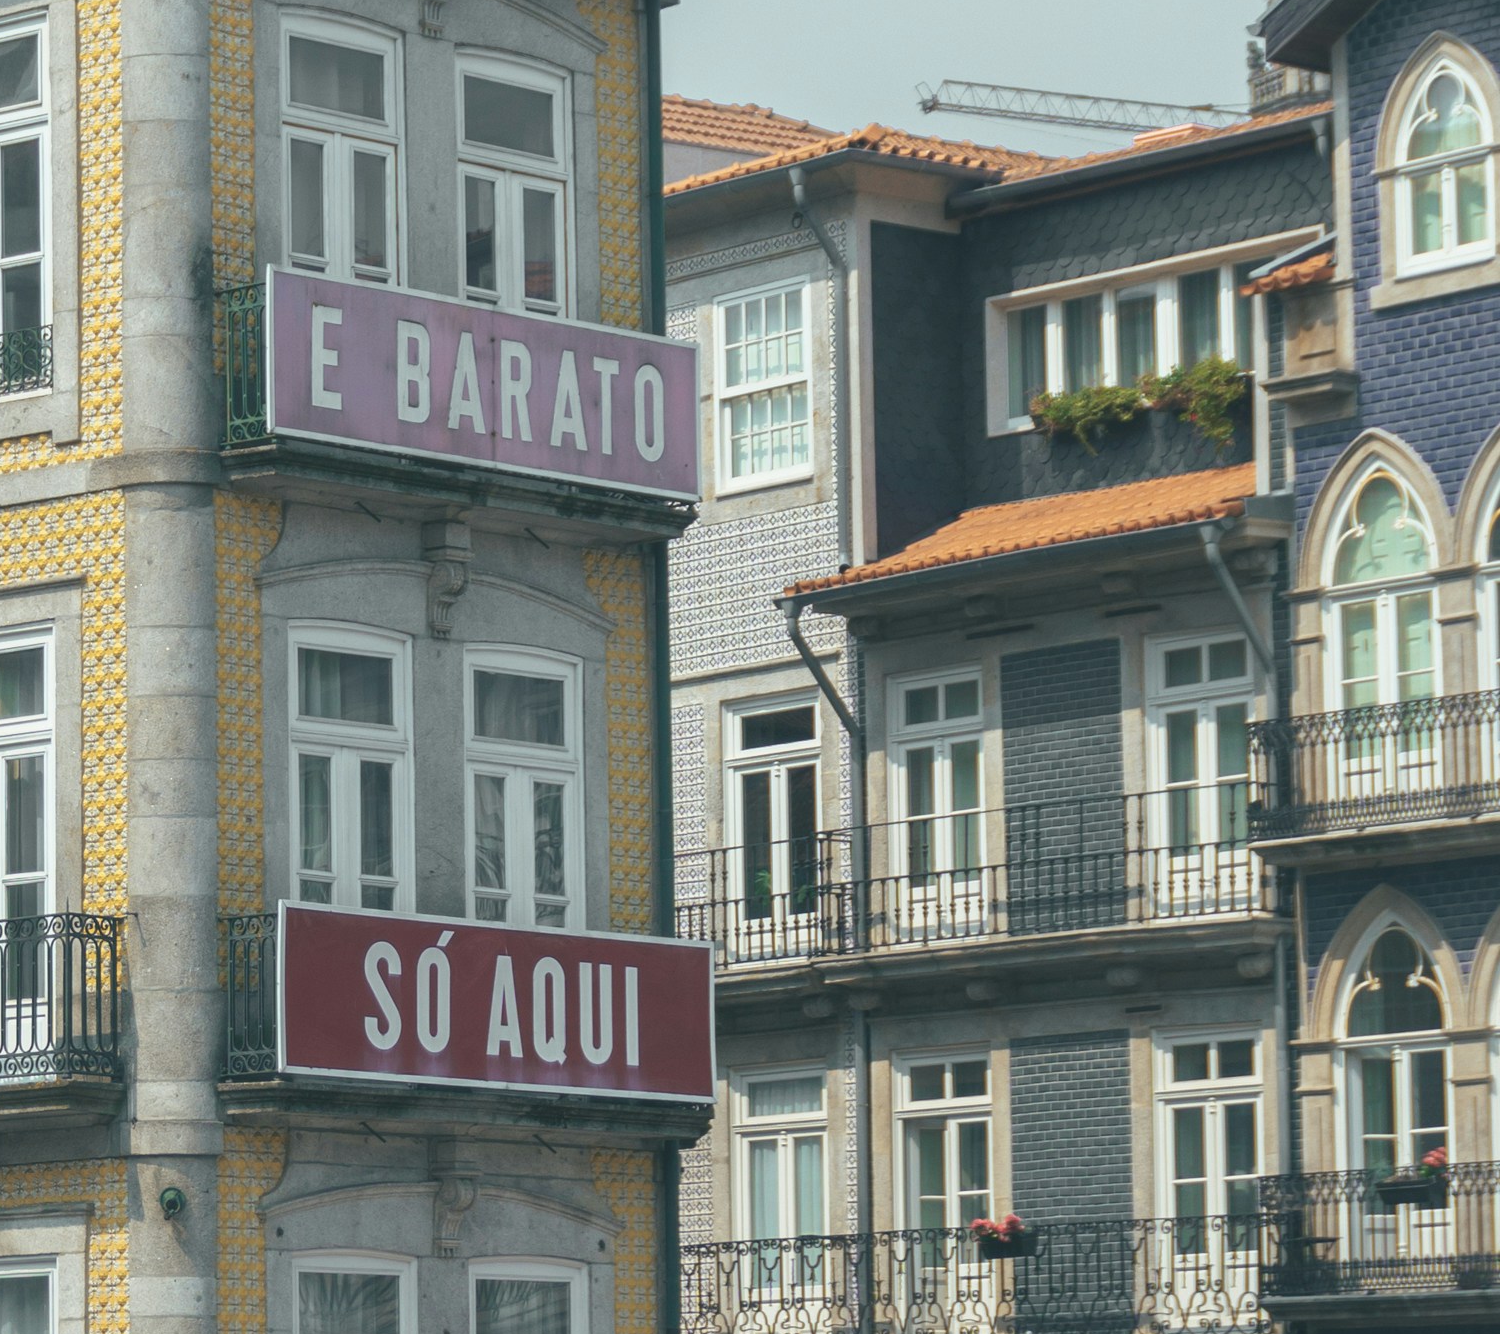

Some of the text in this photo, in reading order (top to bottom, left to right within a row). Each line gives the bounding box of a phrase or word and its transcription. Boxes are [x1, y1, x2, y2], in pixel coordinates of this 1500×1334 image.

[312, 304, 664, 462] E BARATO
[364, 930, 640, 1067] SÓ AQUI
